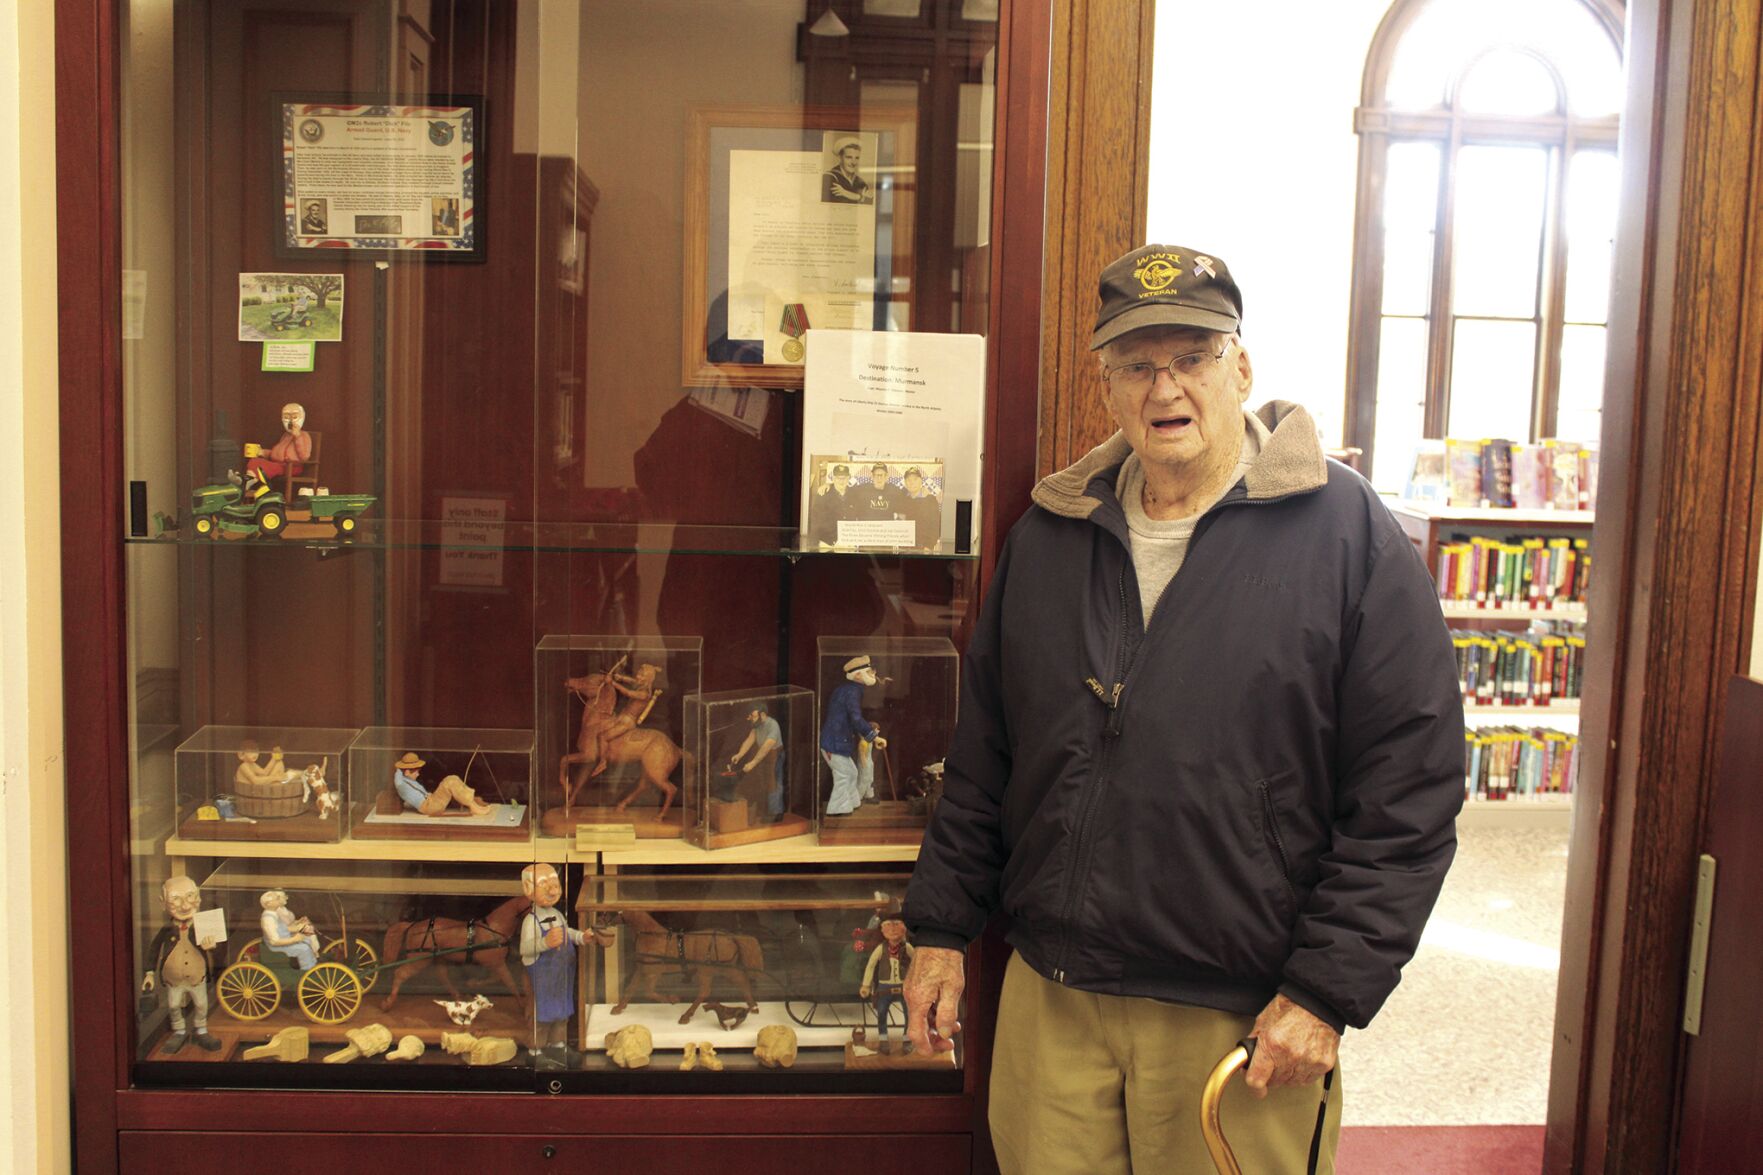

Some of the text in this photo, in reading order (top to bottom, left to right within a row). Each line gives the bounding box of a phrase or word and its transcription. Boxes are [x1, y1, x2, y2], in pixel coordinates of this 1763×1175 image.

[1138, 289, 1178, 298] VETERAN
[867, 363, 889, 372] Voyage
[894, 377, 926, 386] Murmansk
